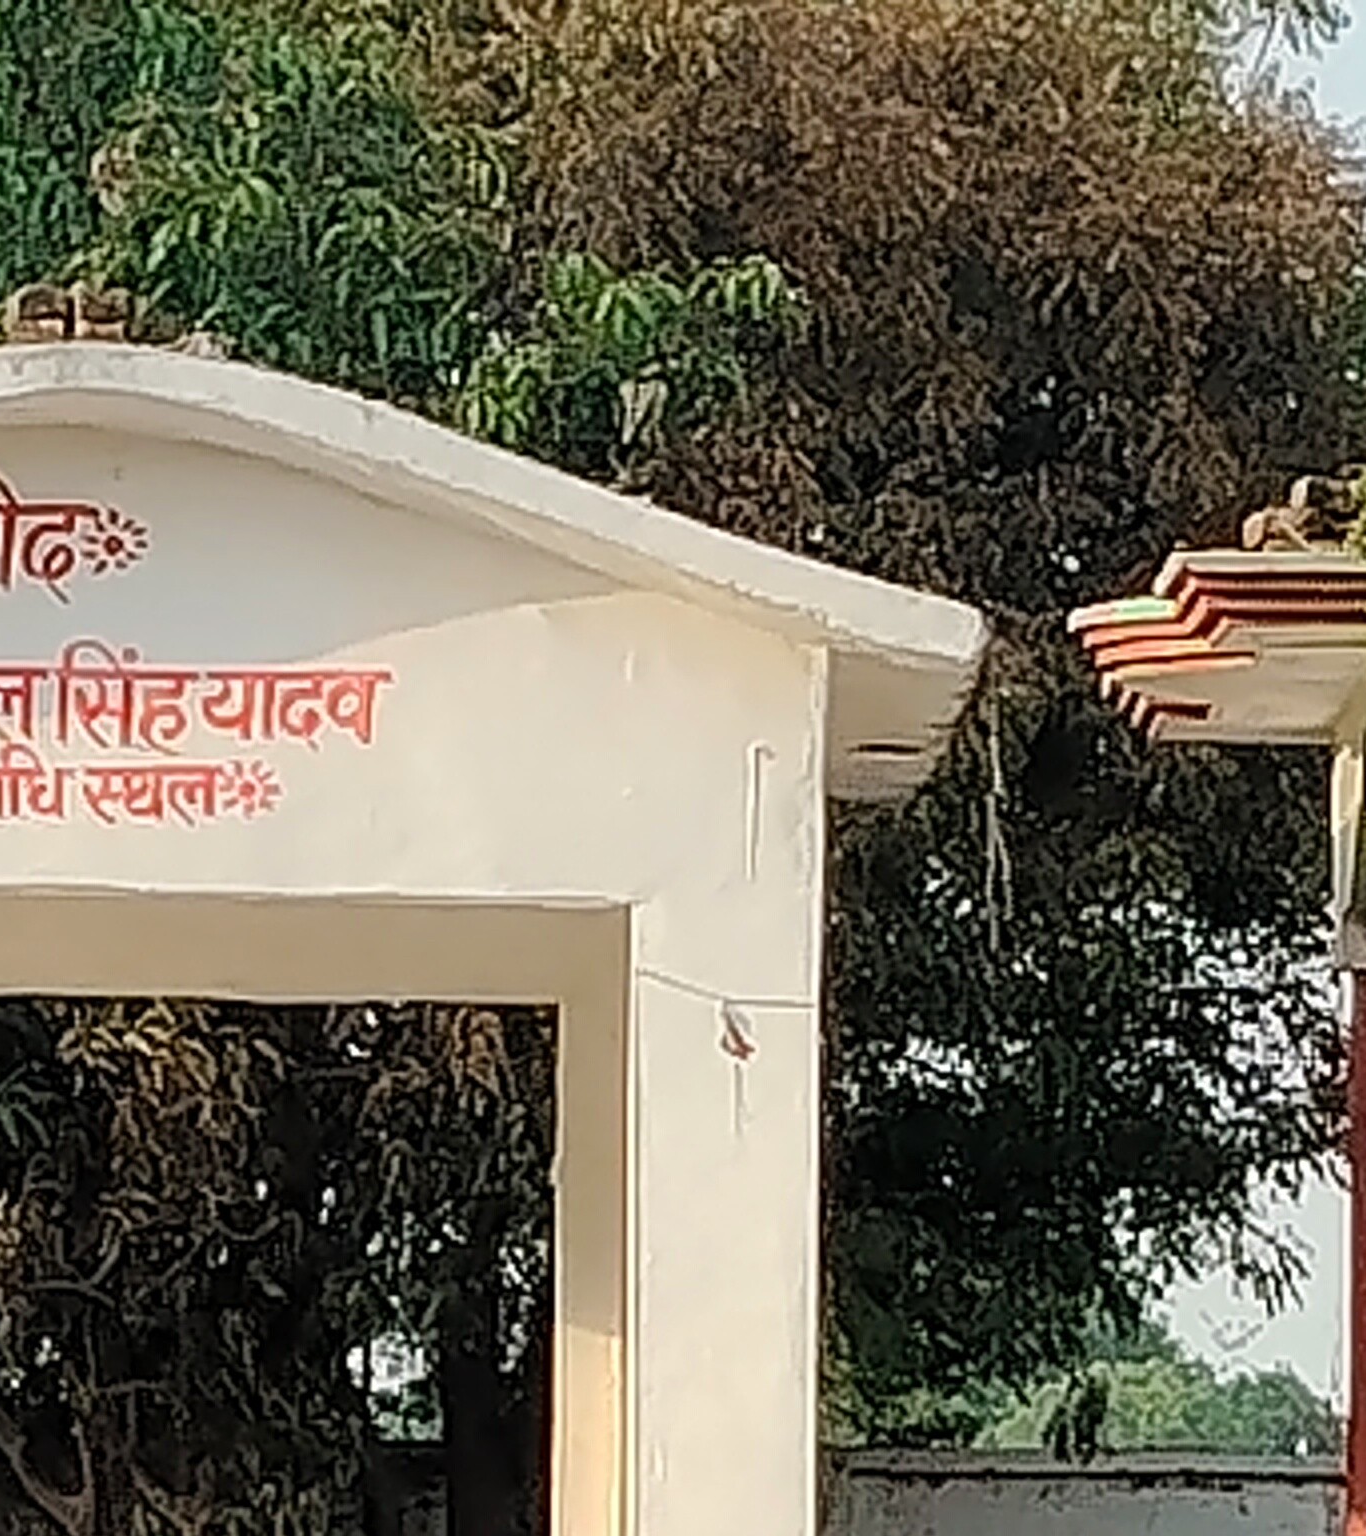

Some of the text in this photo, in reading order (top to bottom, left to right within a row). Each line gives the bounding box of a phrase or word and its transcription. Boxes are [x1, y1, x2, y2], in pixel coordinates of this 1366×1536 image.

[53, 640, 200, 755] सिंह
[201, 671, 392, 751] यादव
[81, 764, 221, 826] स्थल
